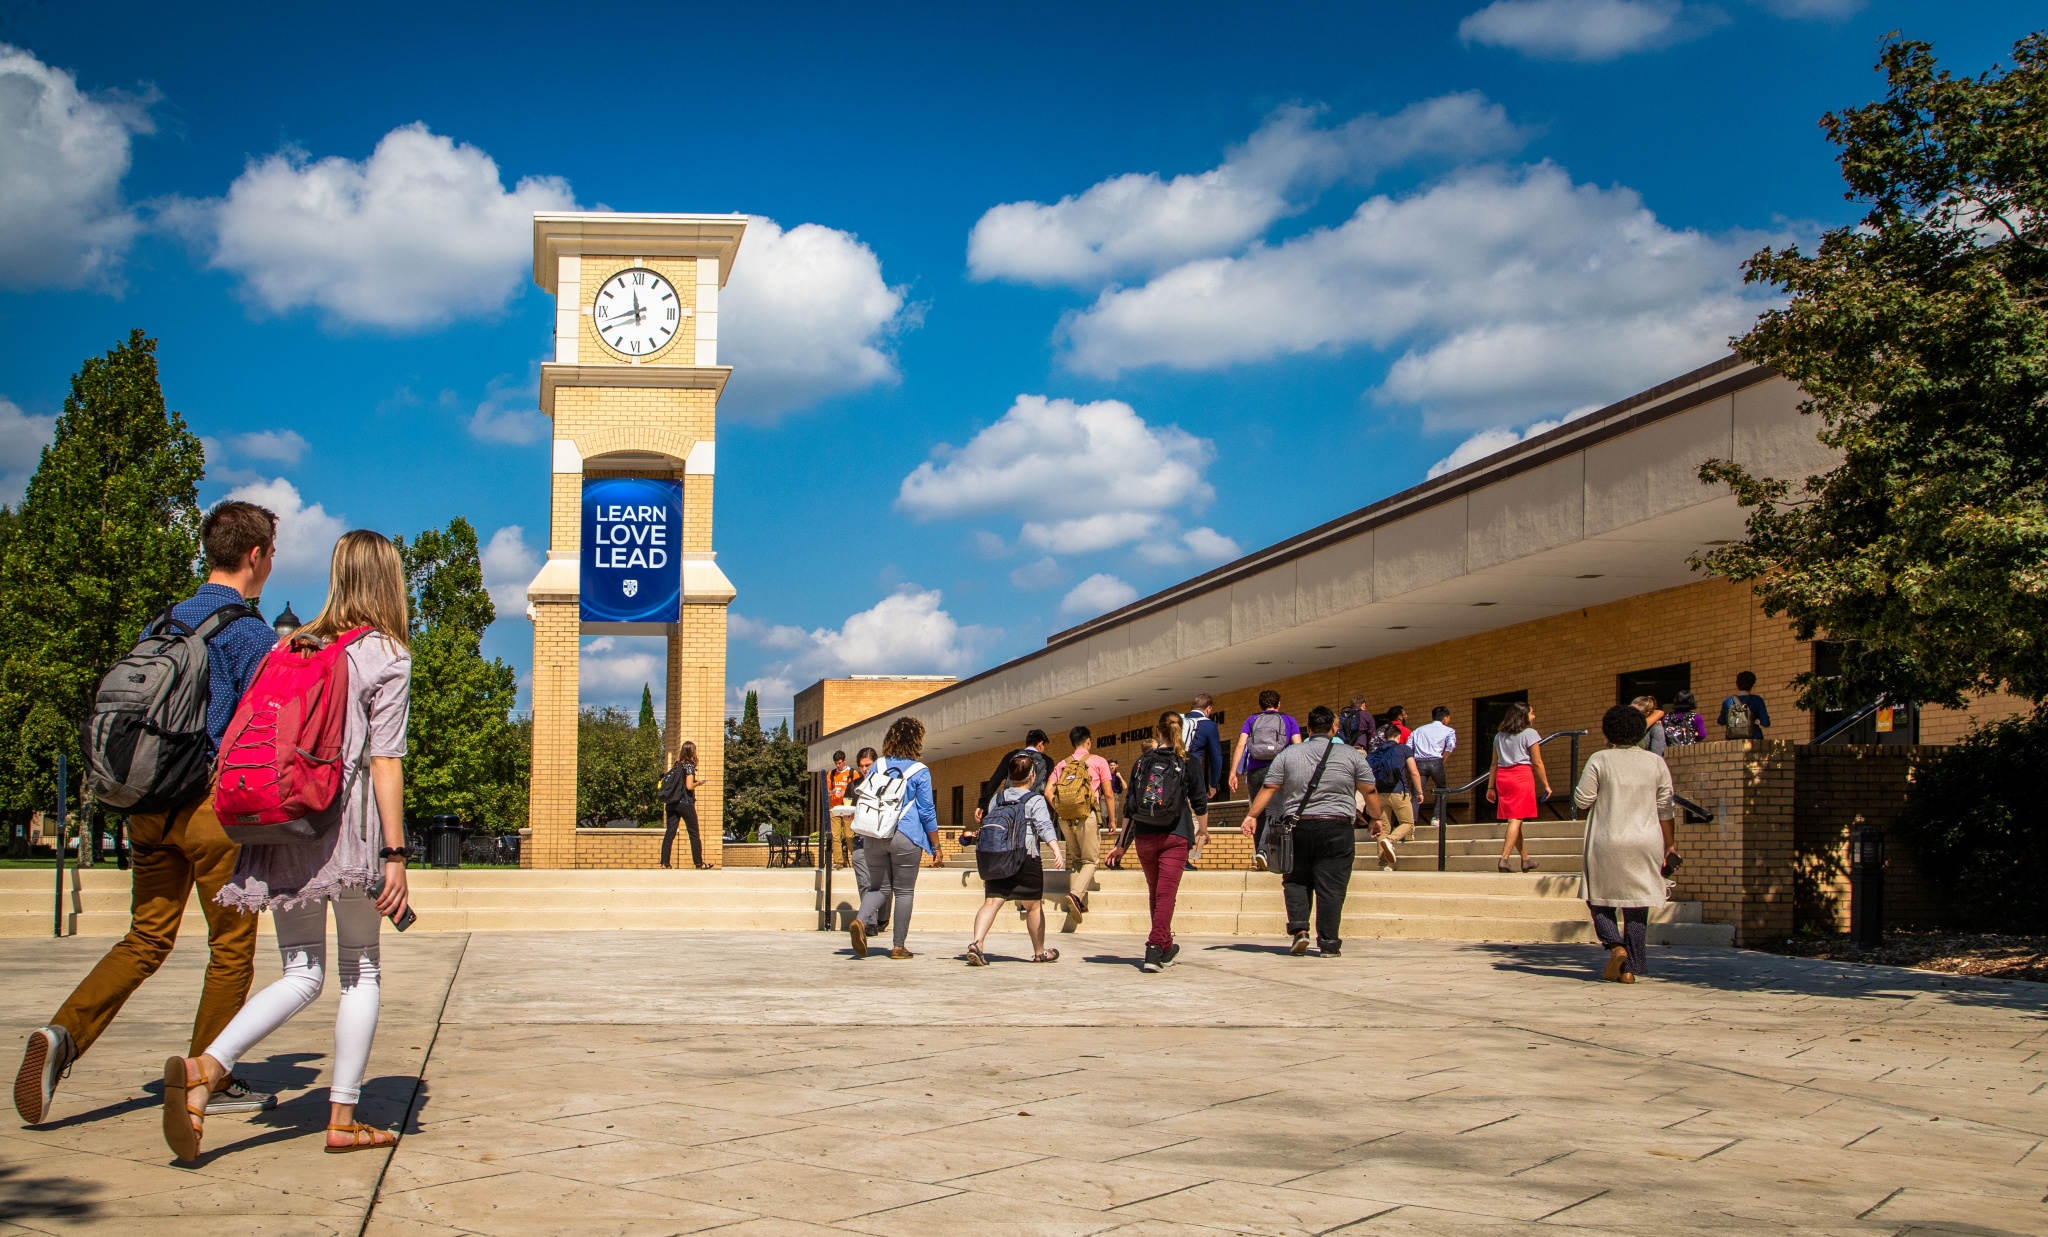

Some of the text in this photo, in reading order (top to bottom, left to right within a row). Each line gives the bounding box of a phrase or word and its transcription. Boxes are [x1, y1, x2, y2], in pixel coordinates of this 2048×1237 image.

[632, 272, 645, 286] XII
[598, 305, 609, 318] IX
[666, 308, 676, 320] III
[630, 341, 640, 353] VI
[596, 505, 667, 522] LEARN
[595, 524, 667, 545] LOVE
[595, 547, 668, 569] LEAD
